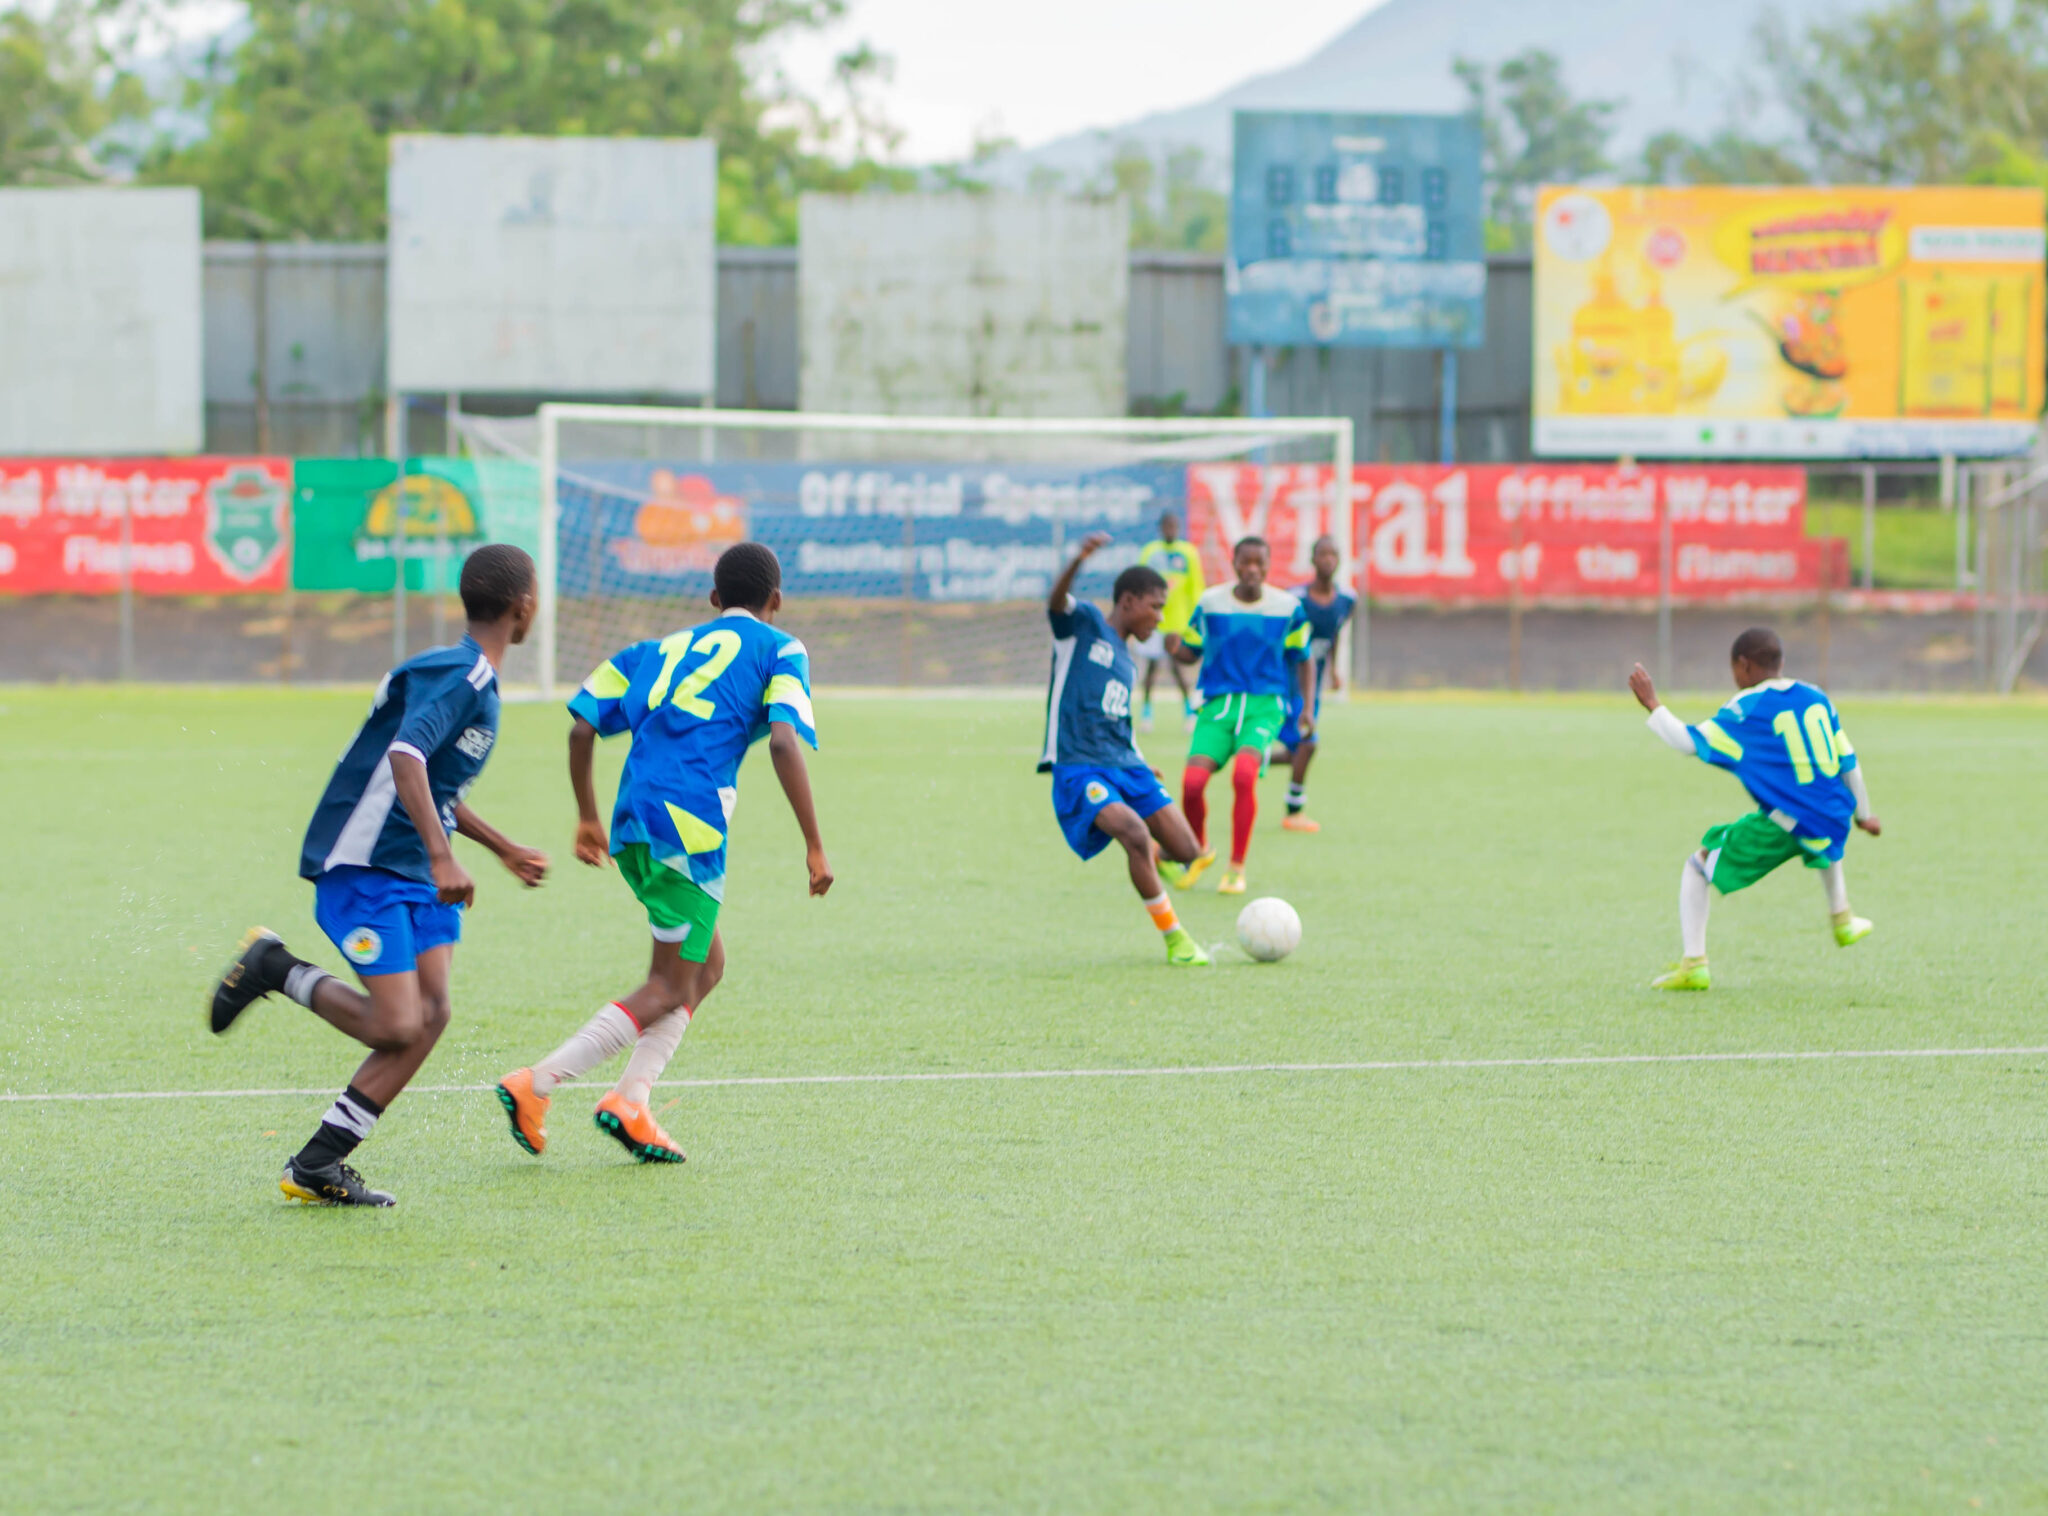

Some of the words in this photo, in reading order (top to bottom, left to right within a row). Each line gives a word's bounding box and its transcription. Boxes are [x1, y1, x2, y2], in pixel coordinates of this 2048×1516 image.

[55, 464, 200, 517] Water
[801, 470, 962, 518] Official
[982, 472, 1154, 525] Sponsor
[1498, 474, 1657, 523] Official
[1664, 475, 1802, 525] Water
[64, 534, 194, 575] Flames
[1498, 542, 1541, 581] of
[1576, 543, 1639, 581] the
[1676, 543, 1797, 582] Flames
[648, 629, 742, 720] 12
[1772, 703, 1841, 785] 10
